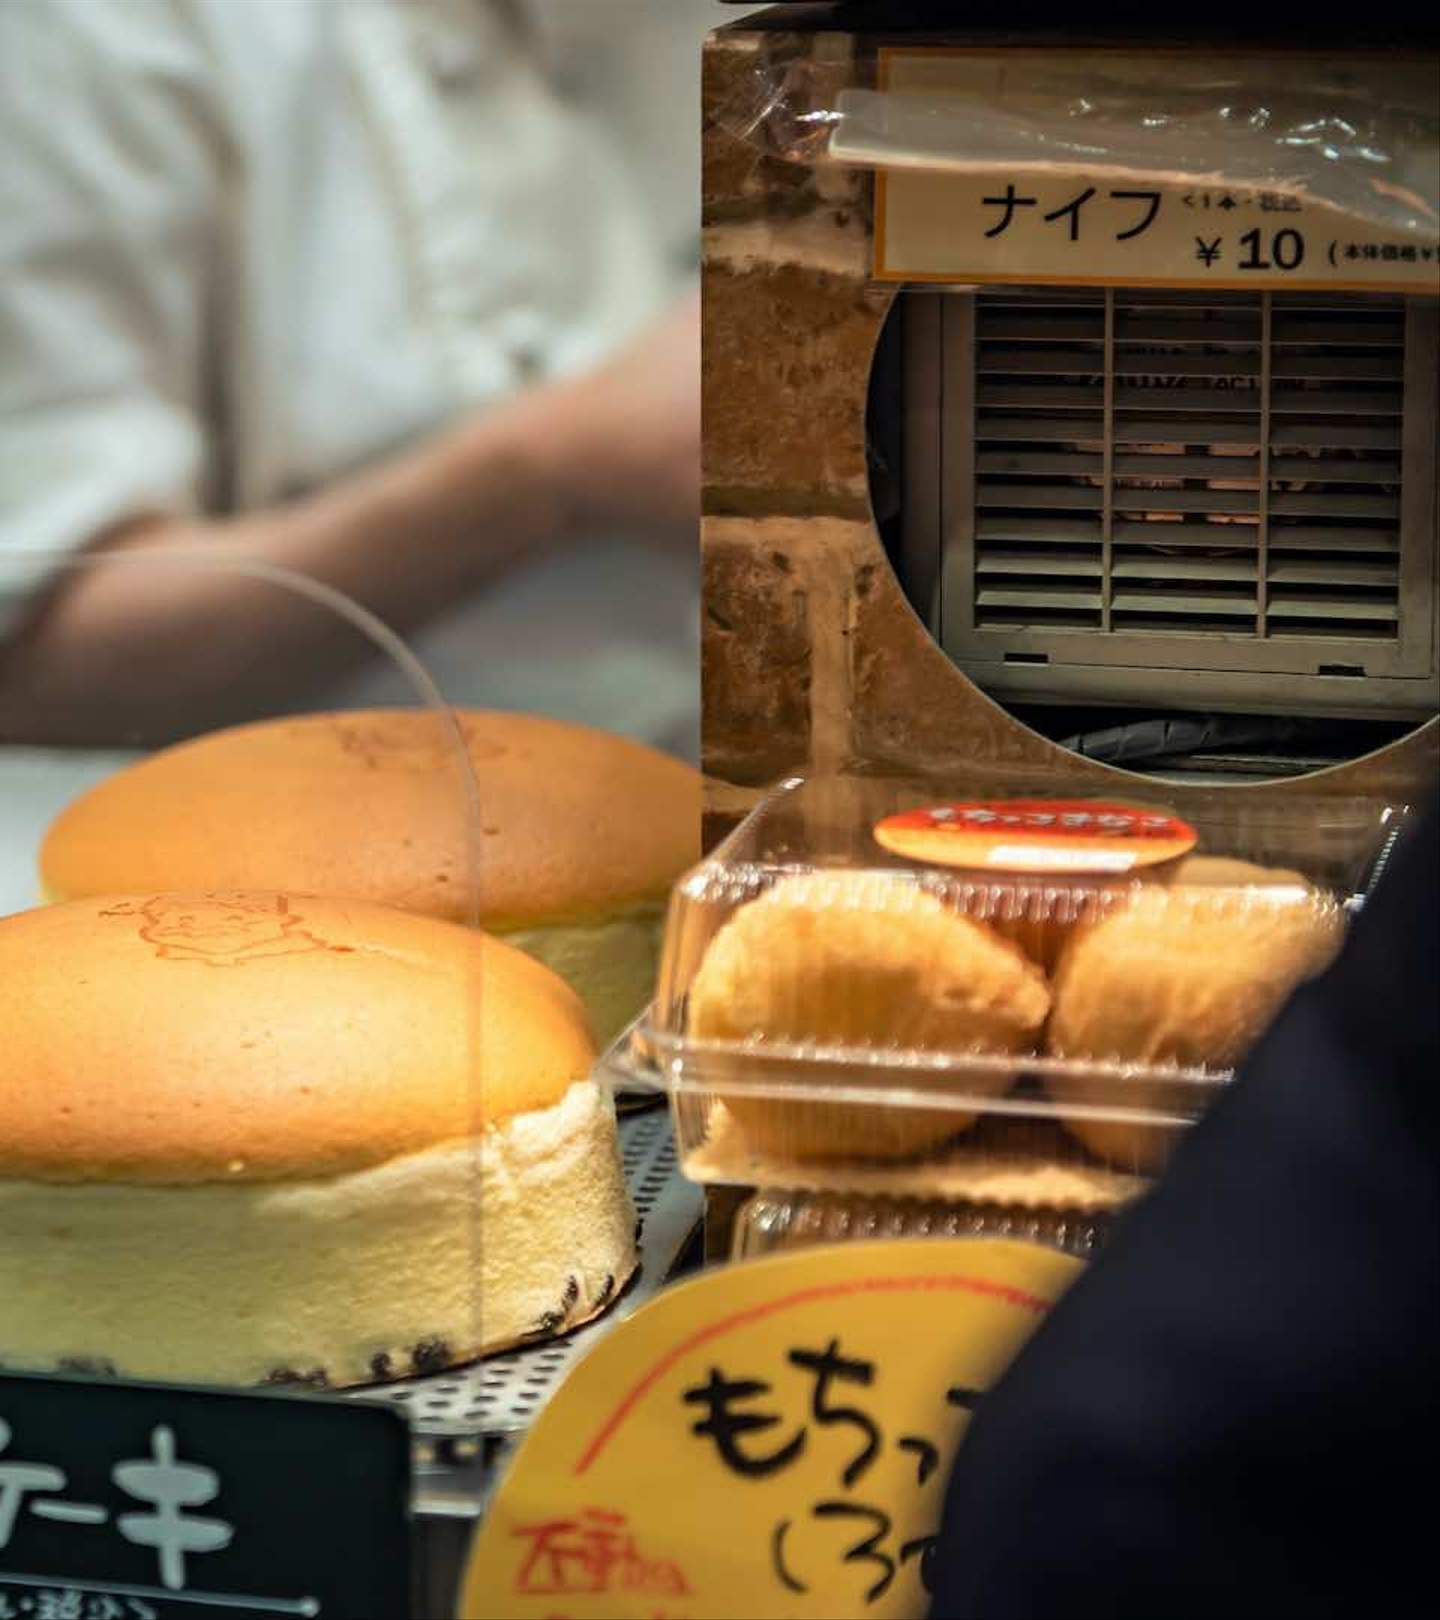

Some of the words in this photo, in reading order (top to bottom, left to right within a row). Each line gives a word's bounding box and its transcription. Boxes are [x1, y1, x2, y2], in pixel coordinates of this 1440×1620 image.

[981, 183, 1162, 241] ナイフ
[1328, 240, 1440, 266] (本体価格¥
